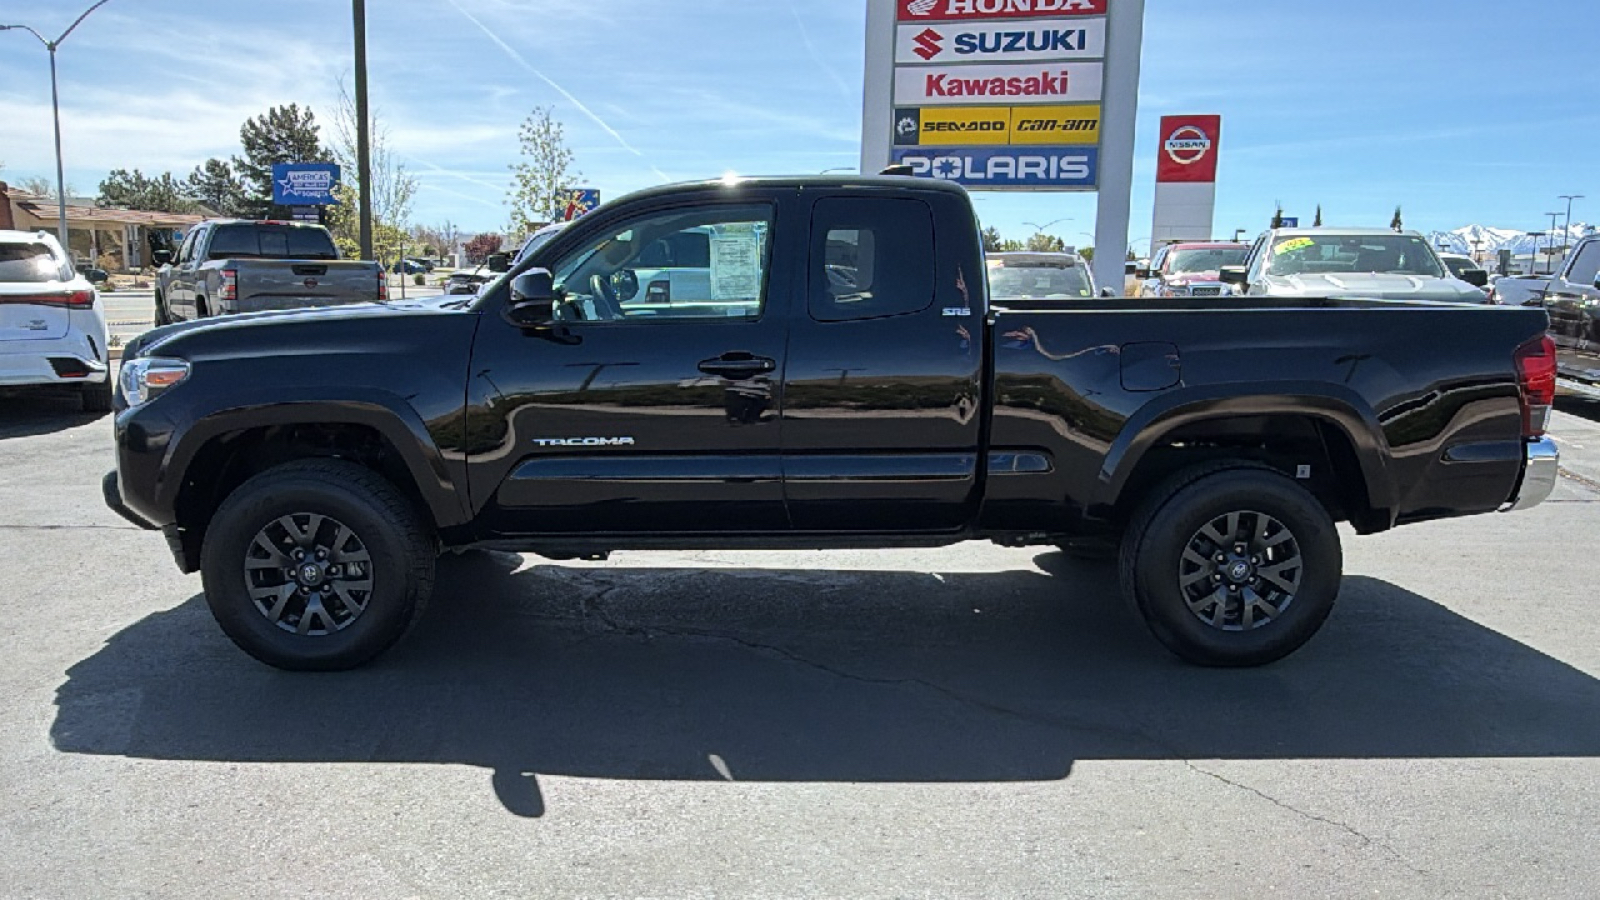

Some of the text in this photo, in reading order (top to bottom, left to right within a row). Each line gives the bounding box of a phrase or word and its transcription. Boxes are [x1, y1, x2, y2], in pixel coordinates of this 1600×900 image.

[954, 29, 1086, 54] SUZUKI
[925, 71, 1068, 97] Kawasaki
[1169, 141, 1206, 149] NISSAN
[902, 155, 1090, 180] POLARIS
[532, 437, 635, 446] TACOMA
